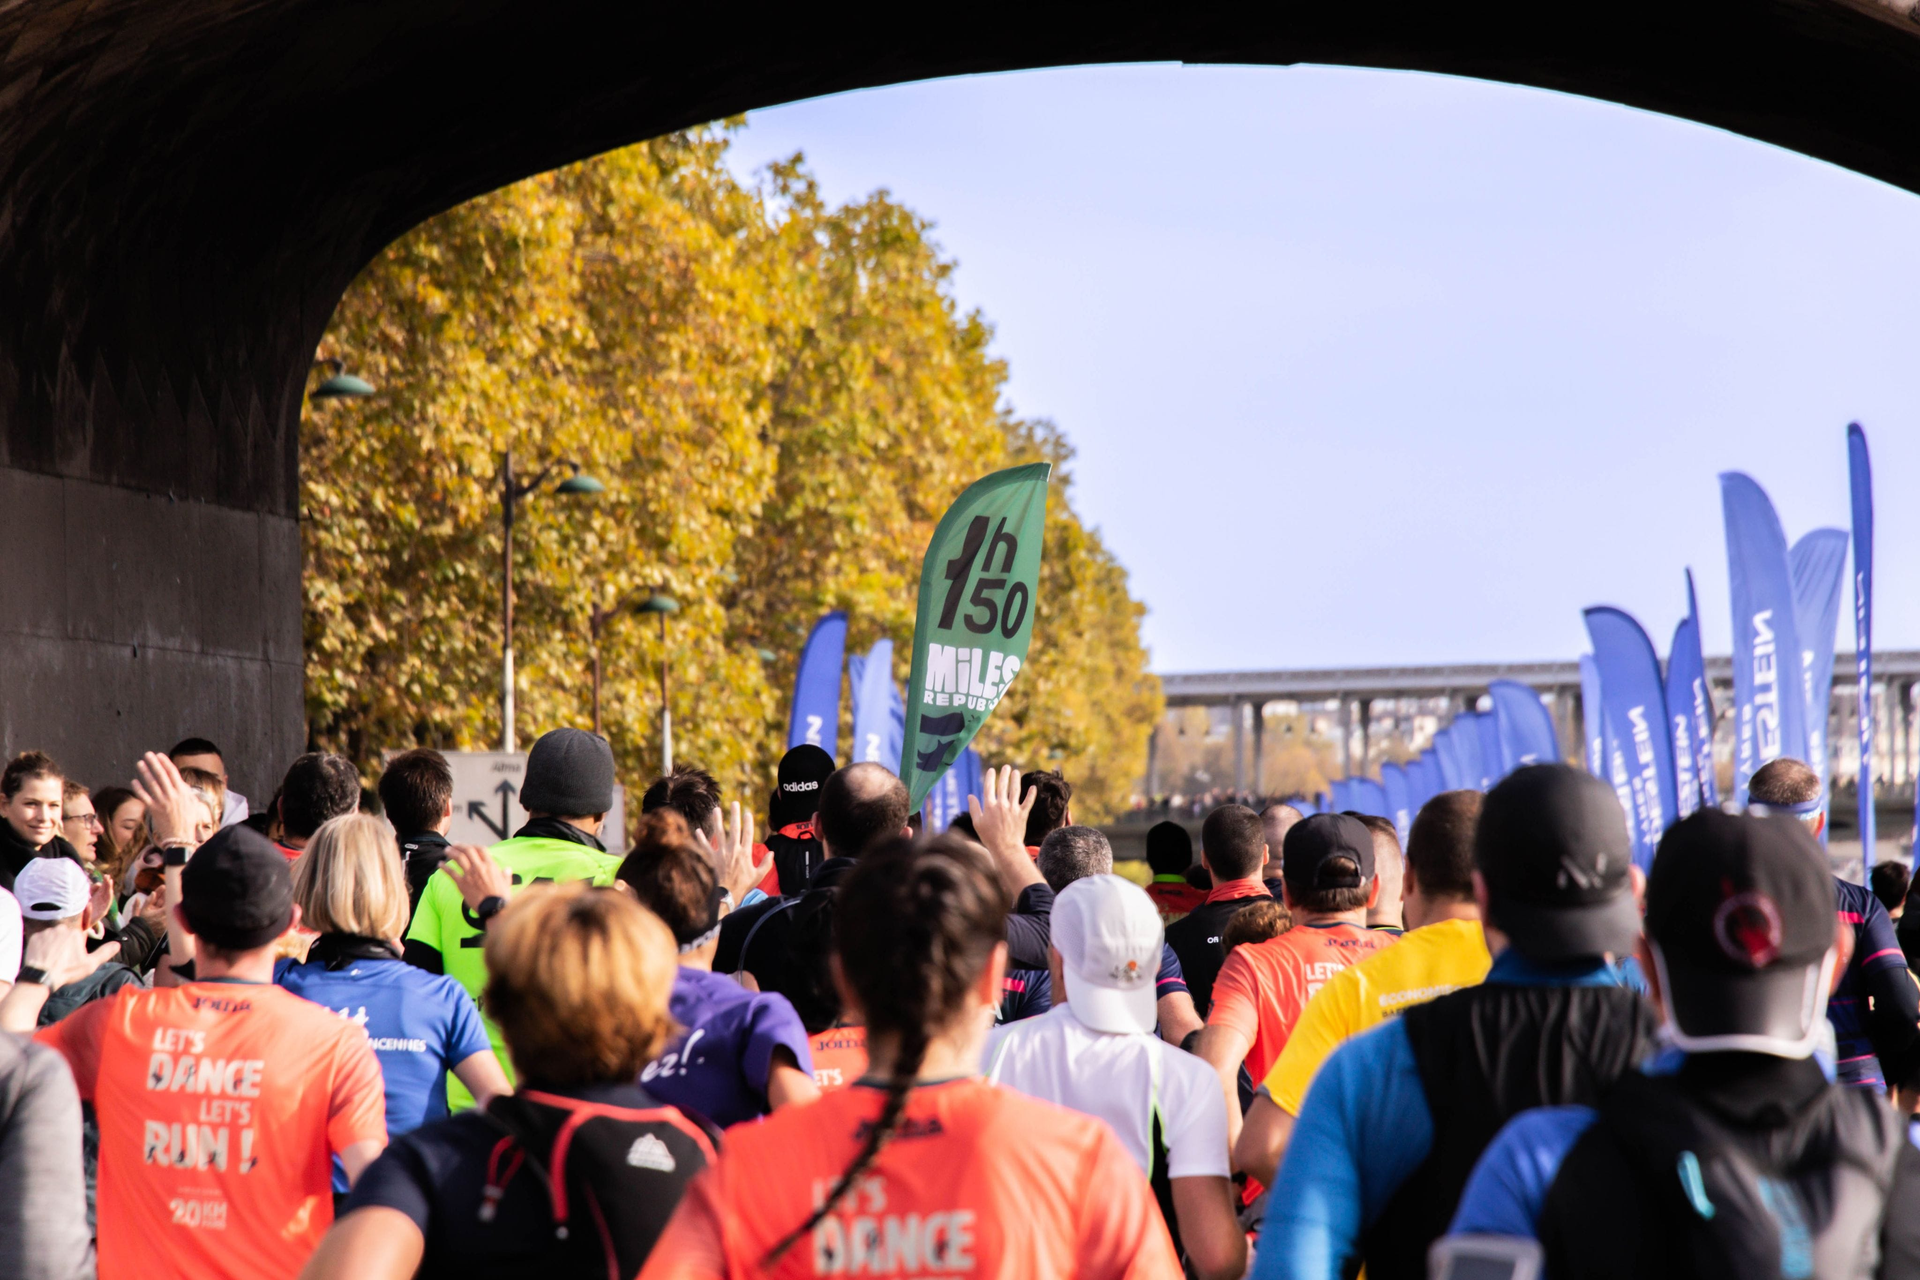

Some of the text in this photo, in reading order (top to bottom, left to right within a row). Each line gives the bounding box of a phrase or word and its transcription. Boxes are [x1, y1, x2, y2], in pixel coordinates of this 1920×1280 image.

[963, 577, 1029, 640] 50
[783, 781, 819, 792] adidas
[153, 1026, 206, 1054] LET'S
[146, 1052, 265, 1098] DANCE
[199, 1098, 252, 1126] LET'S
[144, 1119, 230, 1173] RUN
[170, 1197, 201, 1228] 20
[814, 1209, 977, 1276] DANCE
